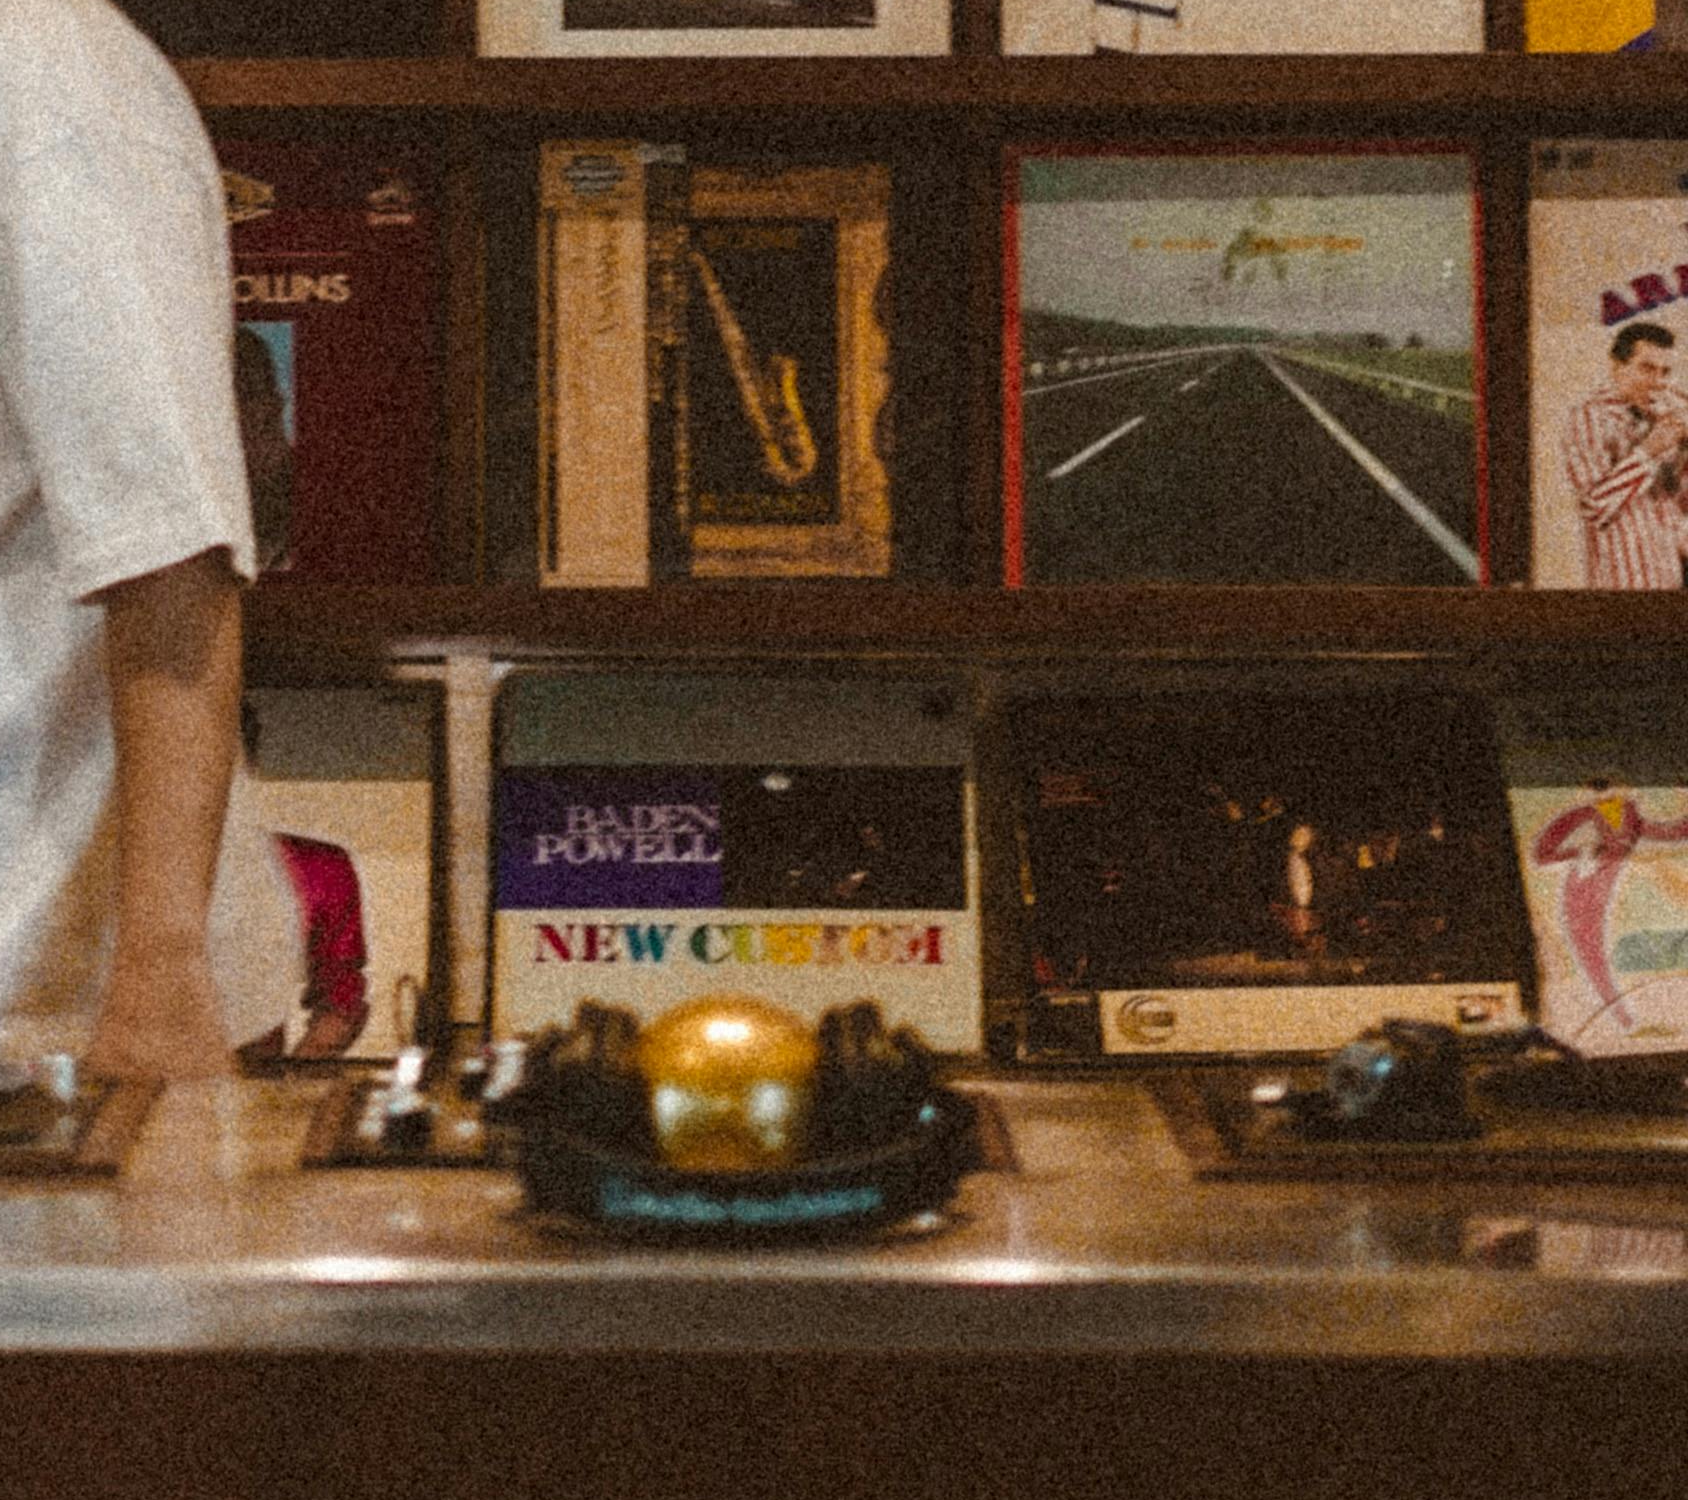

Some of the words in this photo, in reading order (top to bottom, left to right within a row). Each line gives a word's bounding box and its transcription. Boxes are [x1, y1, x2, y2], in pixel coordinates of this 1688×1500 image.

[231, 272, 353, 305] OLLINS
[565, 804, 721, 834] BADEN
[530, 832, 724, 867] POWELL
[532, 922, 678, 965] NEW
